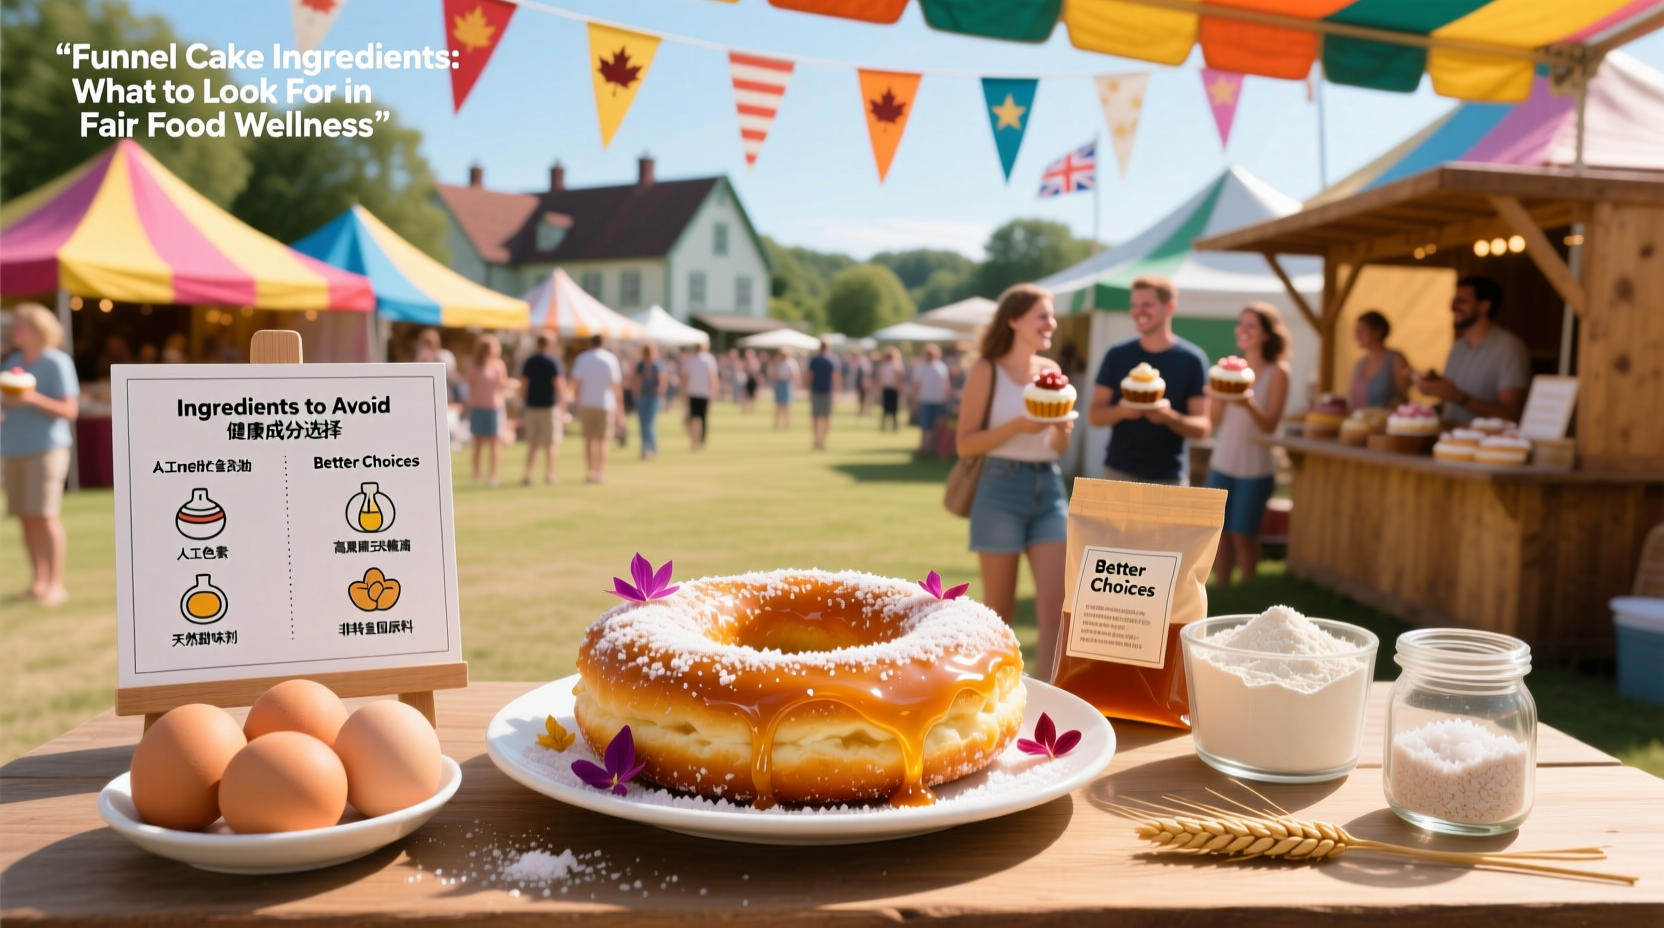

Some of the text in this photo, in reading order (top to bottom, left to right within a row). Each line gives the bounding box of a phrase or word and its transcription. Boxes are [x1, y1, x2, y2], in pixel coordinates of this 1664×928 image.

[177, 395, 391, 421] Ingredients to Avoid
[314, 454, 420, 470] Better Choices
[1095, 559, 1147, 577] Better
[1090, 577, 1156, 598] Choices
